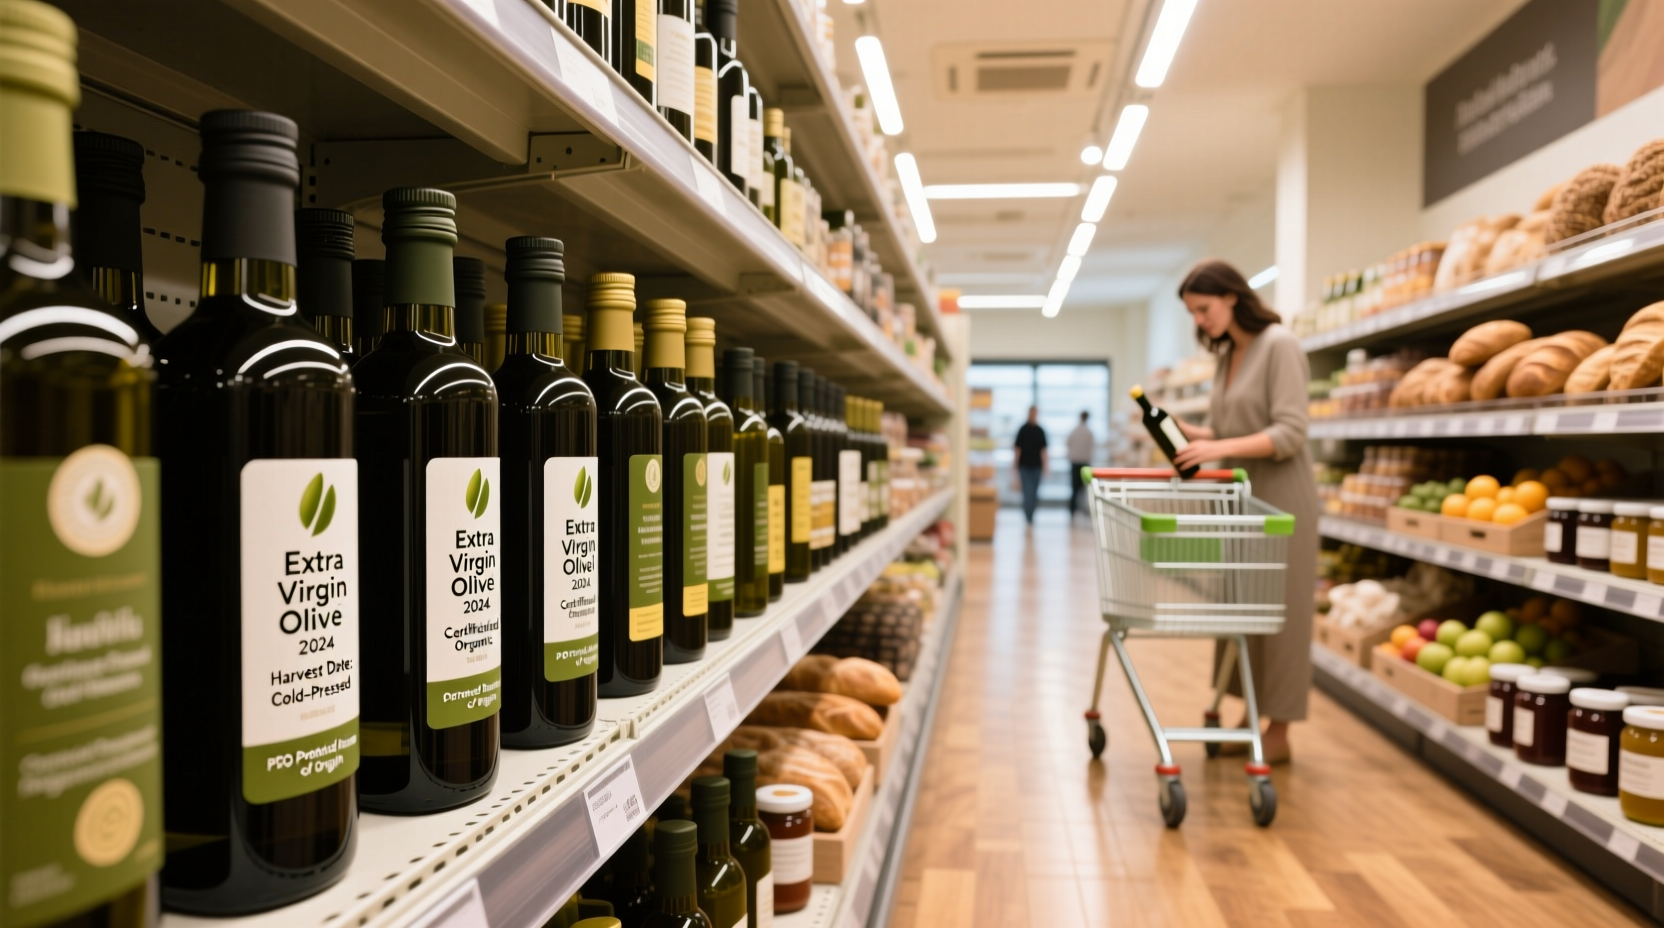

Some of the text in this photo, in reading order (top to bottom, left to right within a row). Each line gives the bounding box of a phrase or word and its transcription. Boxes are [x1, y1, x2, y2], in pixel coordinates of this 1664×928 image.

[566, 519, 595, 535] Extra
[456, 530, 494, 549] Extra
[285, 550, 343, 576] Extra
[448, 550, 496, 576] Virgin
[277, 576, 347, 607] Virgin
[451, 575, 495, 597] Olive
[463, 597, 491, 614] 2024
[279, 607, 342, 635] Olive
[298, 635, 335, 656] 2024
[271, 665, 323, 686] Harvest
[271, 674, 351, 707] Cold-Pressed
